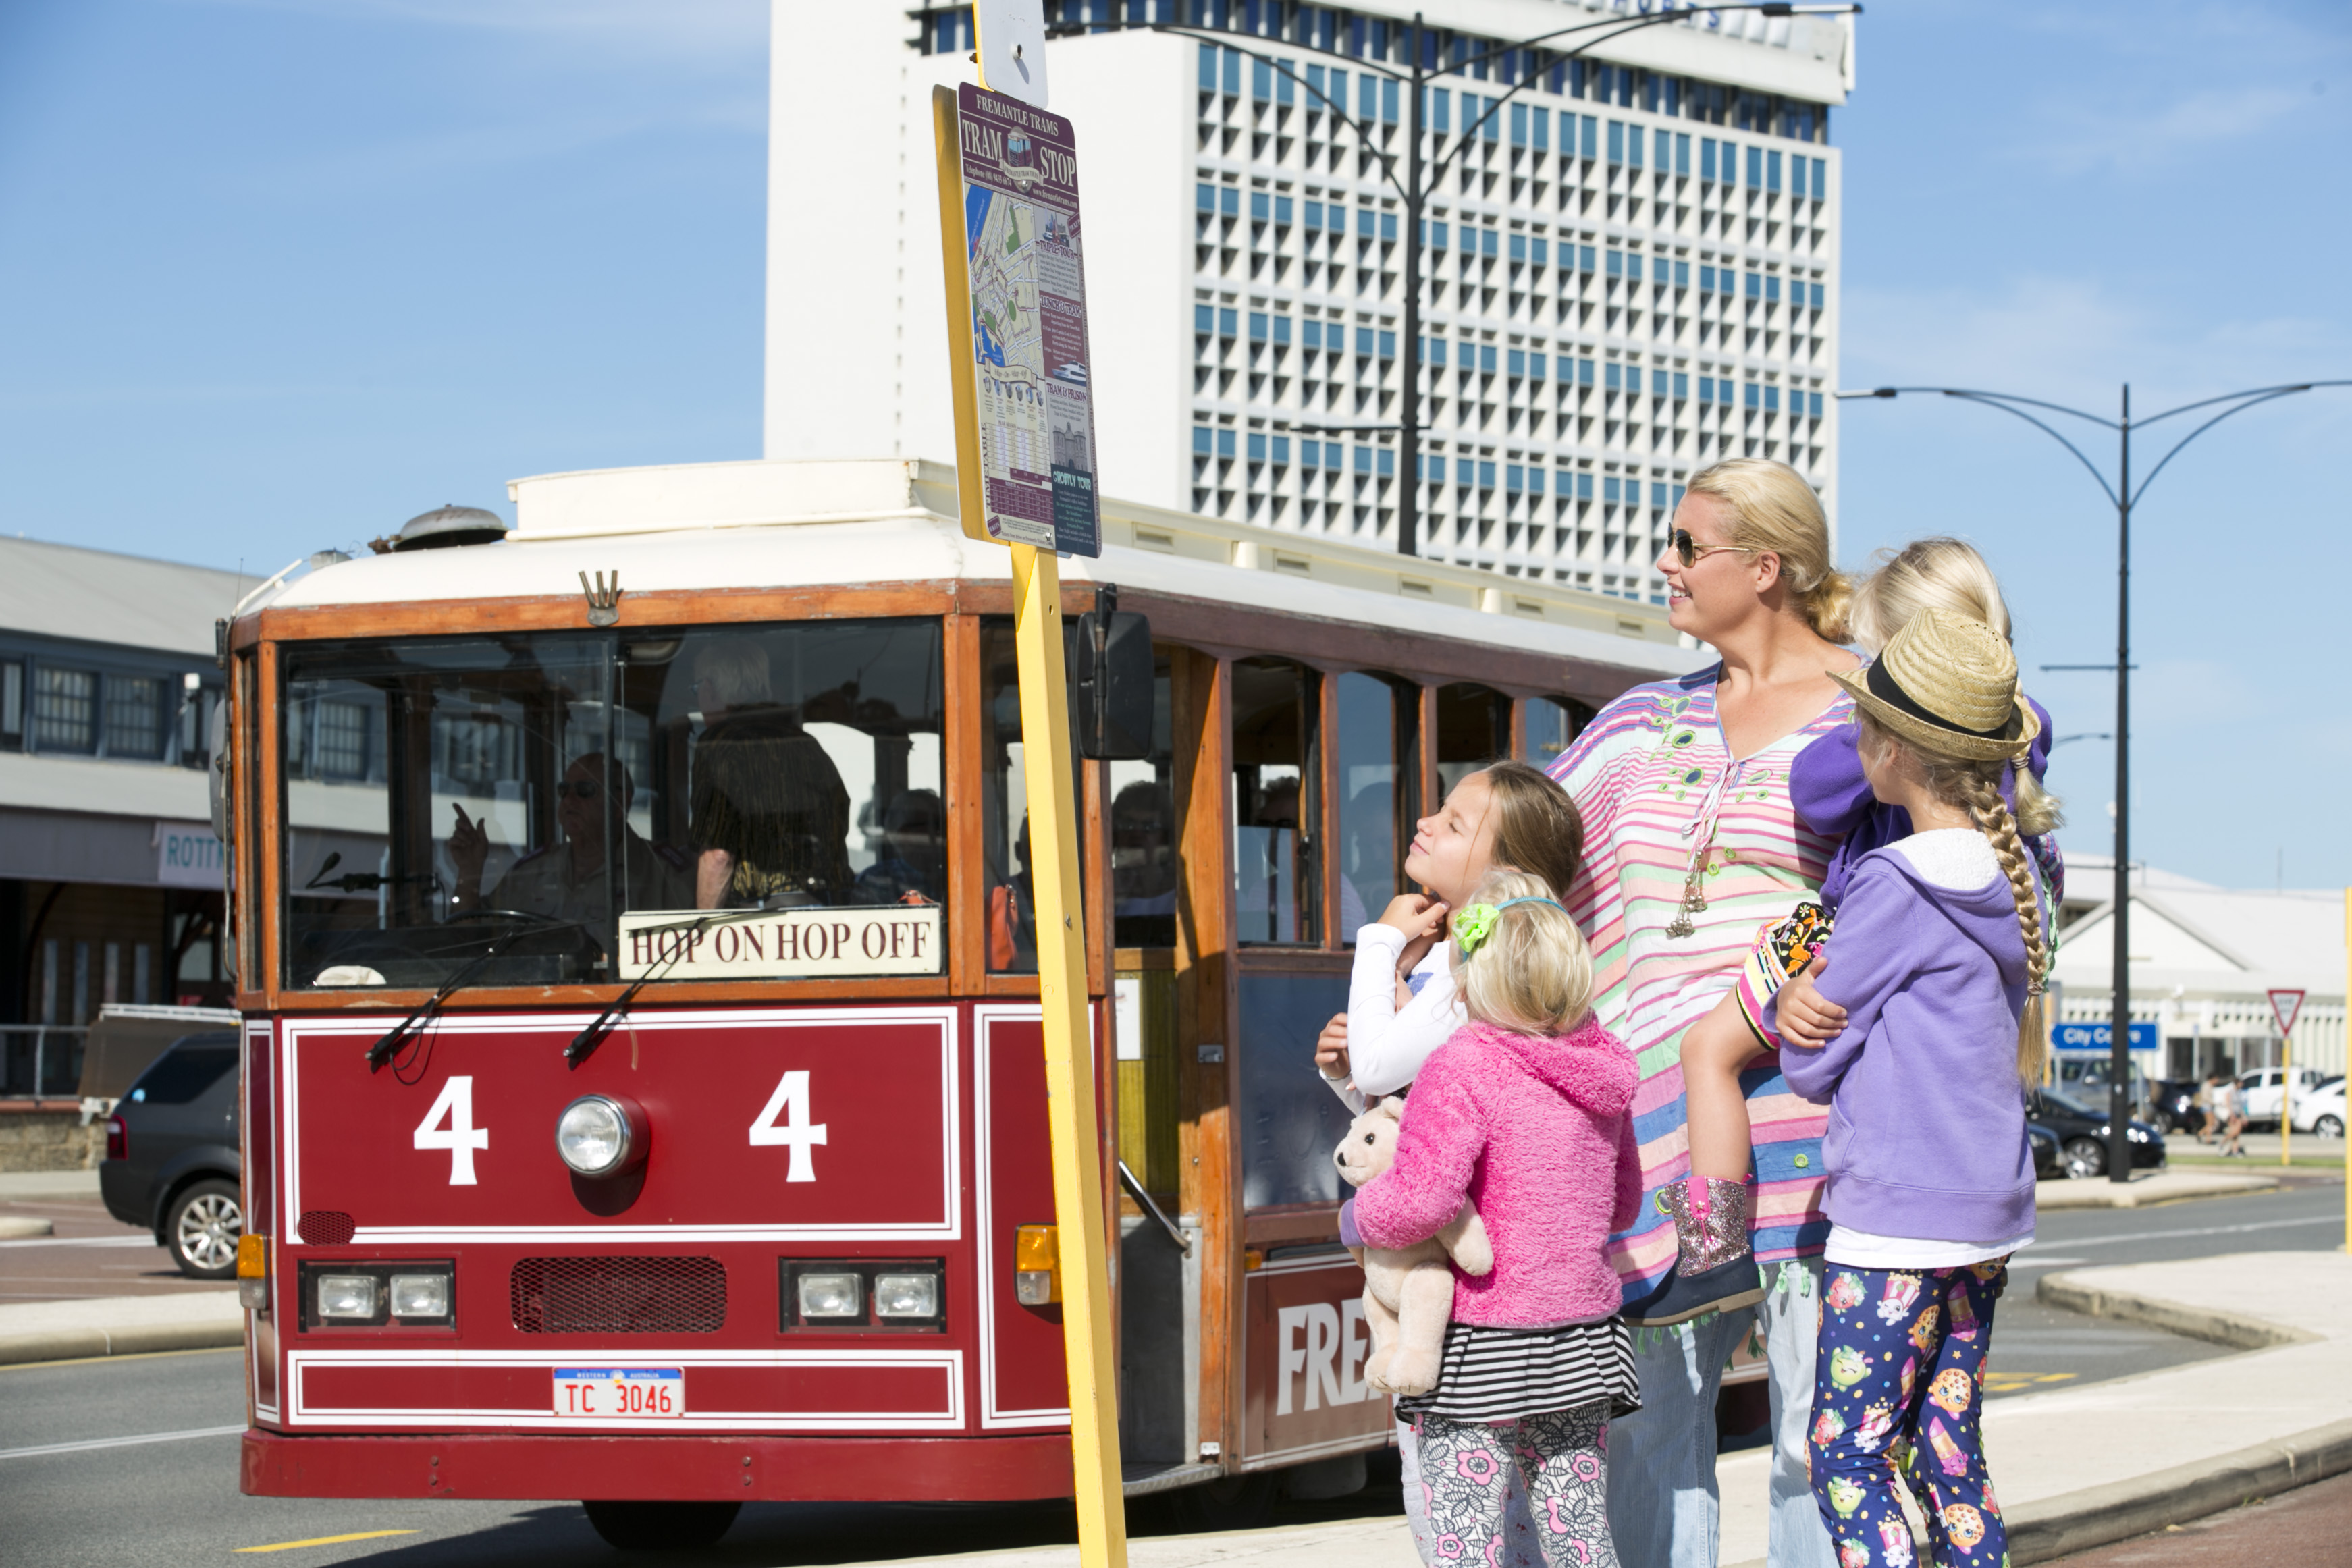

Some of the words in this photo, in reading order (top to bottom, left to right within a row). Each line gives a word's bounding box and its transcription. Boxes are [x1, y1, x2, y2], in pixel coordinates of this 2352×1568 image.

[976, 94, 1028, 126] FREMANTLE
[1030, 111, 1059, 136] TRAMS
[962, 119, 1002, 162] TRAM
[1040, 146, 1075, 187] STOP
[965, 163, 985, 178] Telephone
[1040, 240, 1059, 254] TRIPLE
[1059, 246, 1075, 259] TOUR
[1040, 296, 1059, 310] LUNCH
[1066, 303, 1081, 318] TRAM
[1046, 383, 1062, 396] TRAM
[1067, 388, 1087, 402] PRISON
[1053, 471, 1076, 487] GHOSTLY
[1077, 474, 1092, 491] TOUR
[167, 834, 234, 869] ROTT
[630, 927, 704, 965] HOP
[715, 924, 766, 963] ON
[776, 923, 851, 961] HOP
[862, 921, 931, 960] OFF
[2063, 1027, 2092, 1046] City
[2093, 1027, 2141, 1044] Cee
[414, 1075, 489, 1185] 4
[749, 1071, 828, 1182] 4
[1276, 1297, 1383, 1416] FRE
[565, 1384, 595, 1413] TC
[616, 1384, 671, 1413] 3046
